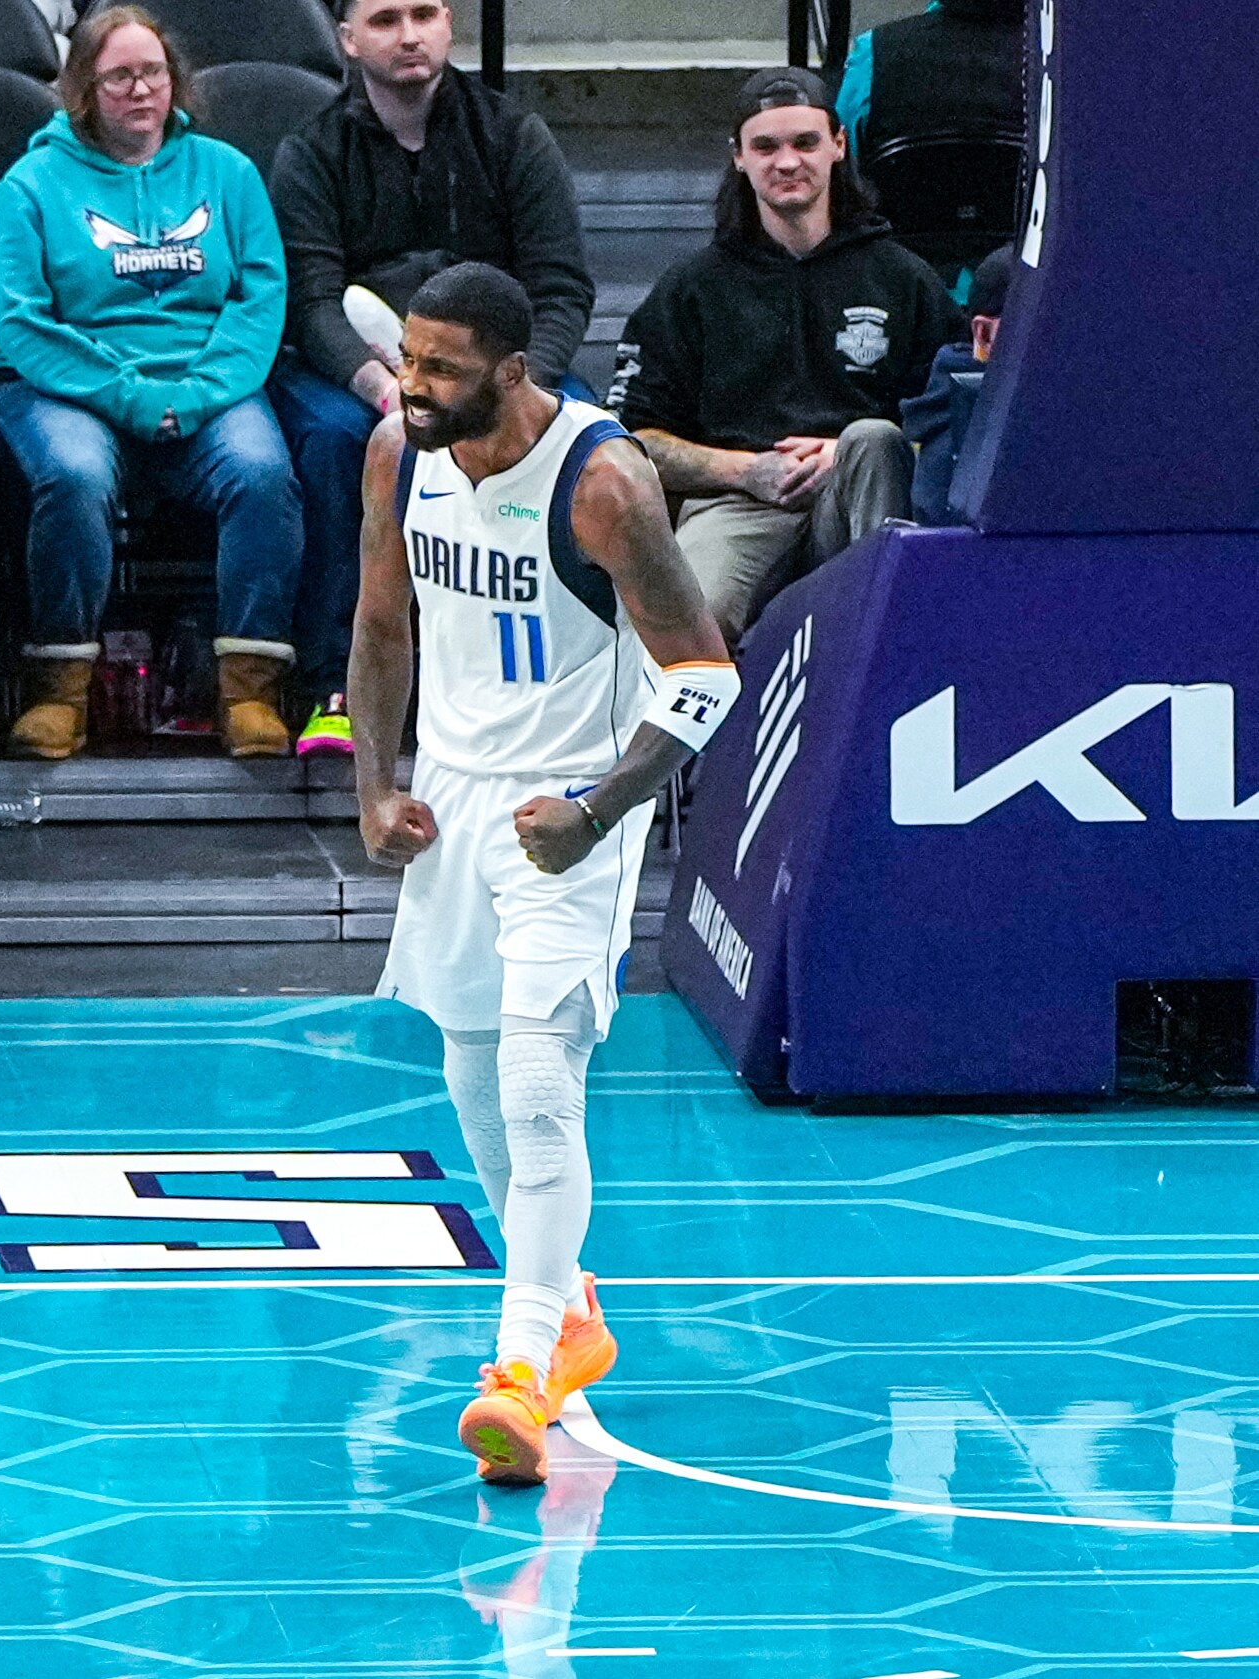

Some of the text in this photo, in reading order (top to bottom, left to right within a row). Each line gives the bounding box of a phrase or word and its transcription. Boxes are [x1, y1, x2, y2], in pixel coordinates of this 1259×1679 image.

[114, 247, 203, 275] HORNETS
[498, 501, 541, 522] chime
[410, 528, 538, 602] DALLAS
[492, 610, 546, 683] 11
[891, 683, 1259, 825] KI
